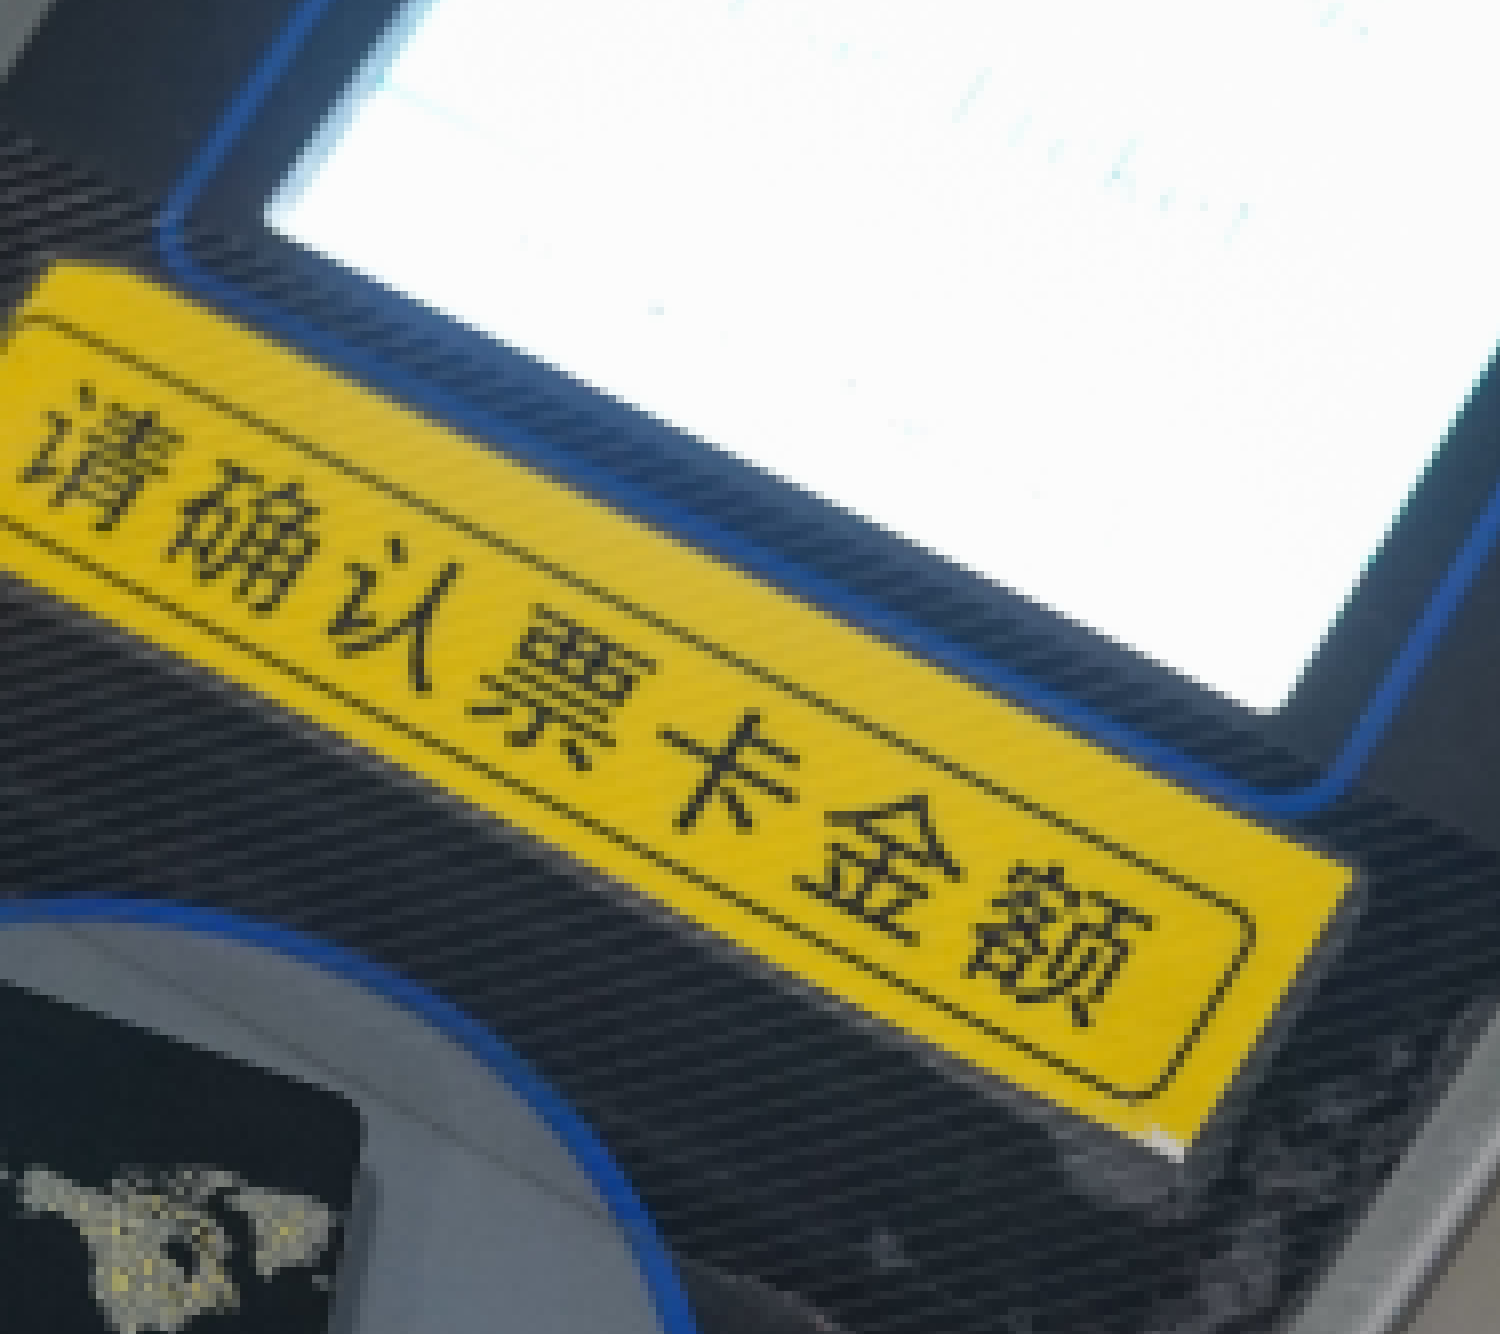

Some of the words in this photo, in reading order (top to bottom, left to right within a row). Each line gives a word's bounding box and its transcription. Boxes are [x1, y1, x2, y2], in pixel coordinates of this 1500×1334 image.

[22, 380, 1160, 1028] 请确认票卡金额
